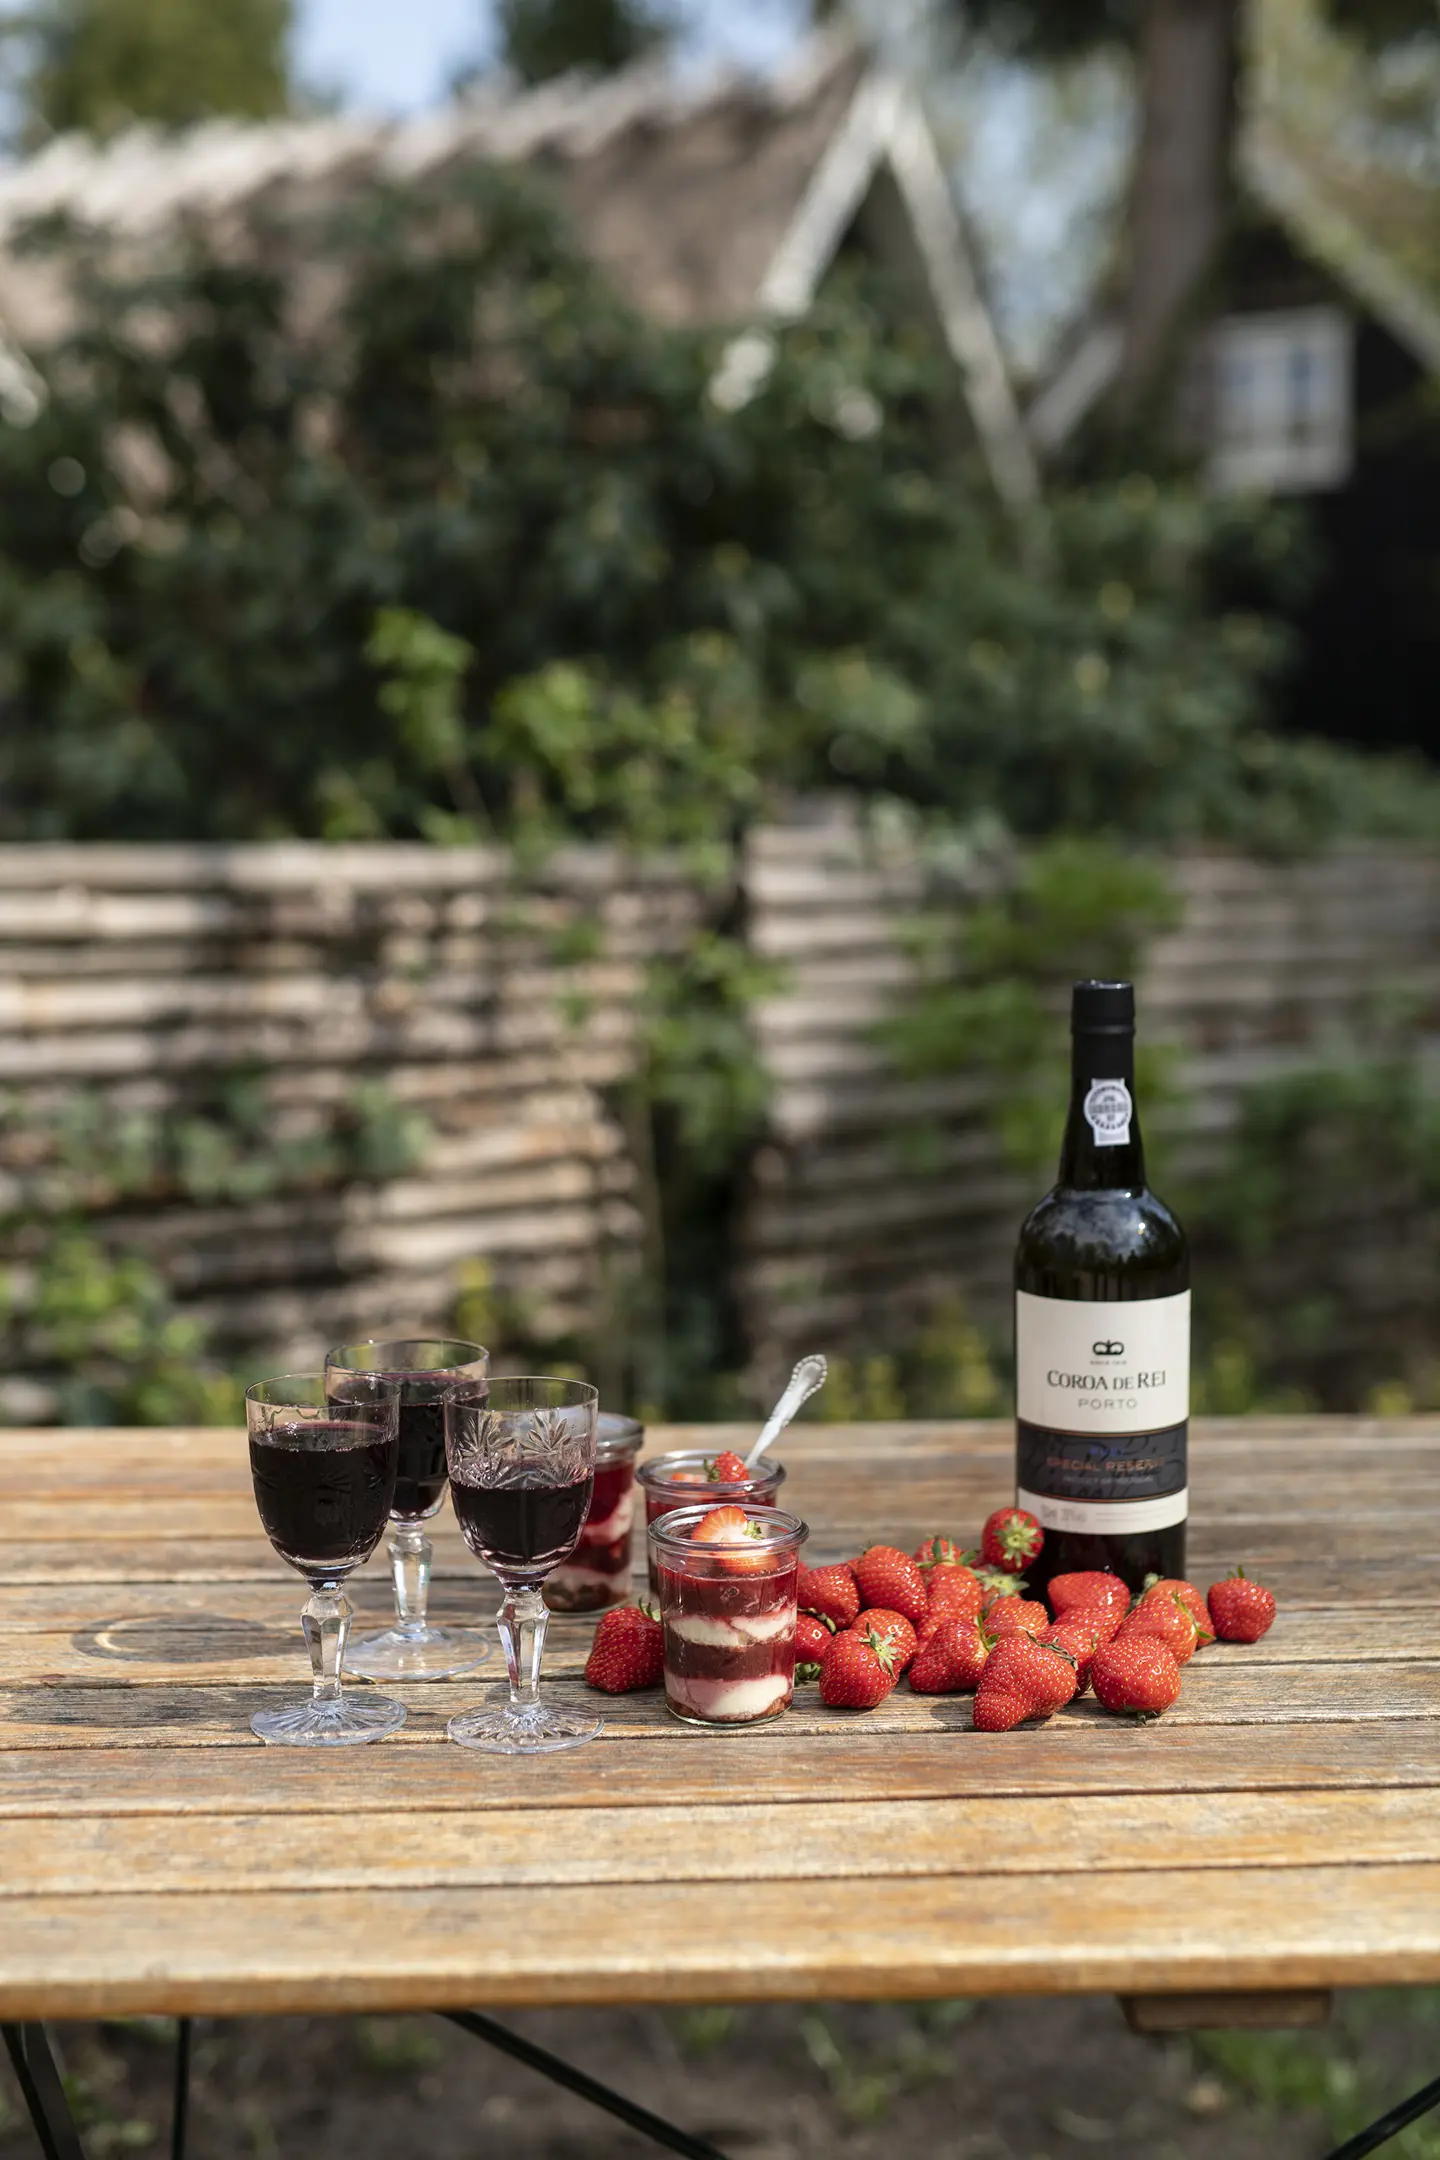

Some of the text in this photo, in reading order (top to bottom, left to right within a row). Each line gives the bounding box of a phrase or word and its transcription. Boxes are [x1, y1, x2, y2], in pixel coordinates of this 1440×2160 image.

[1047, 1369, 1166, 1391] COROA DE REI
[1078, 1398, 1138, 1410] PORTO
